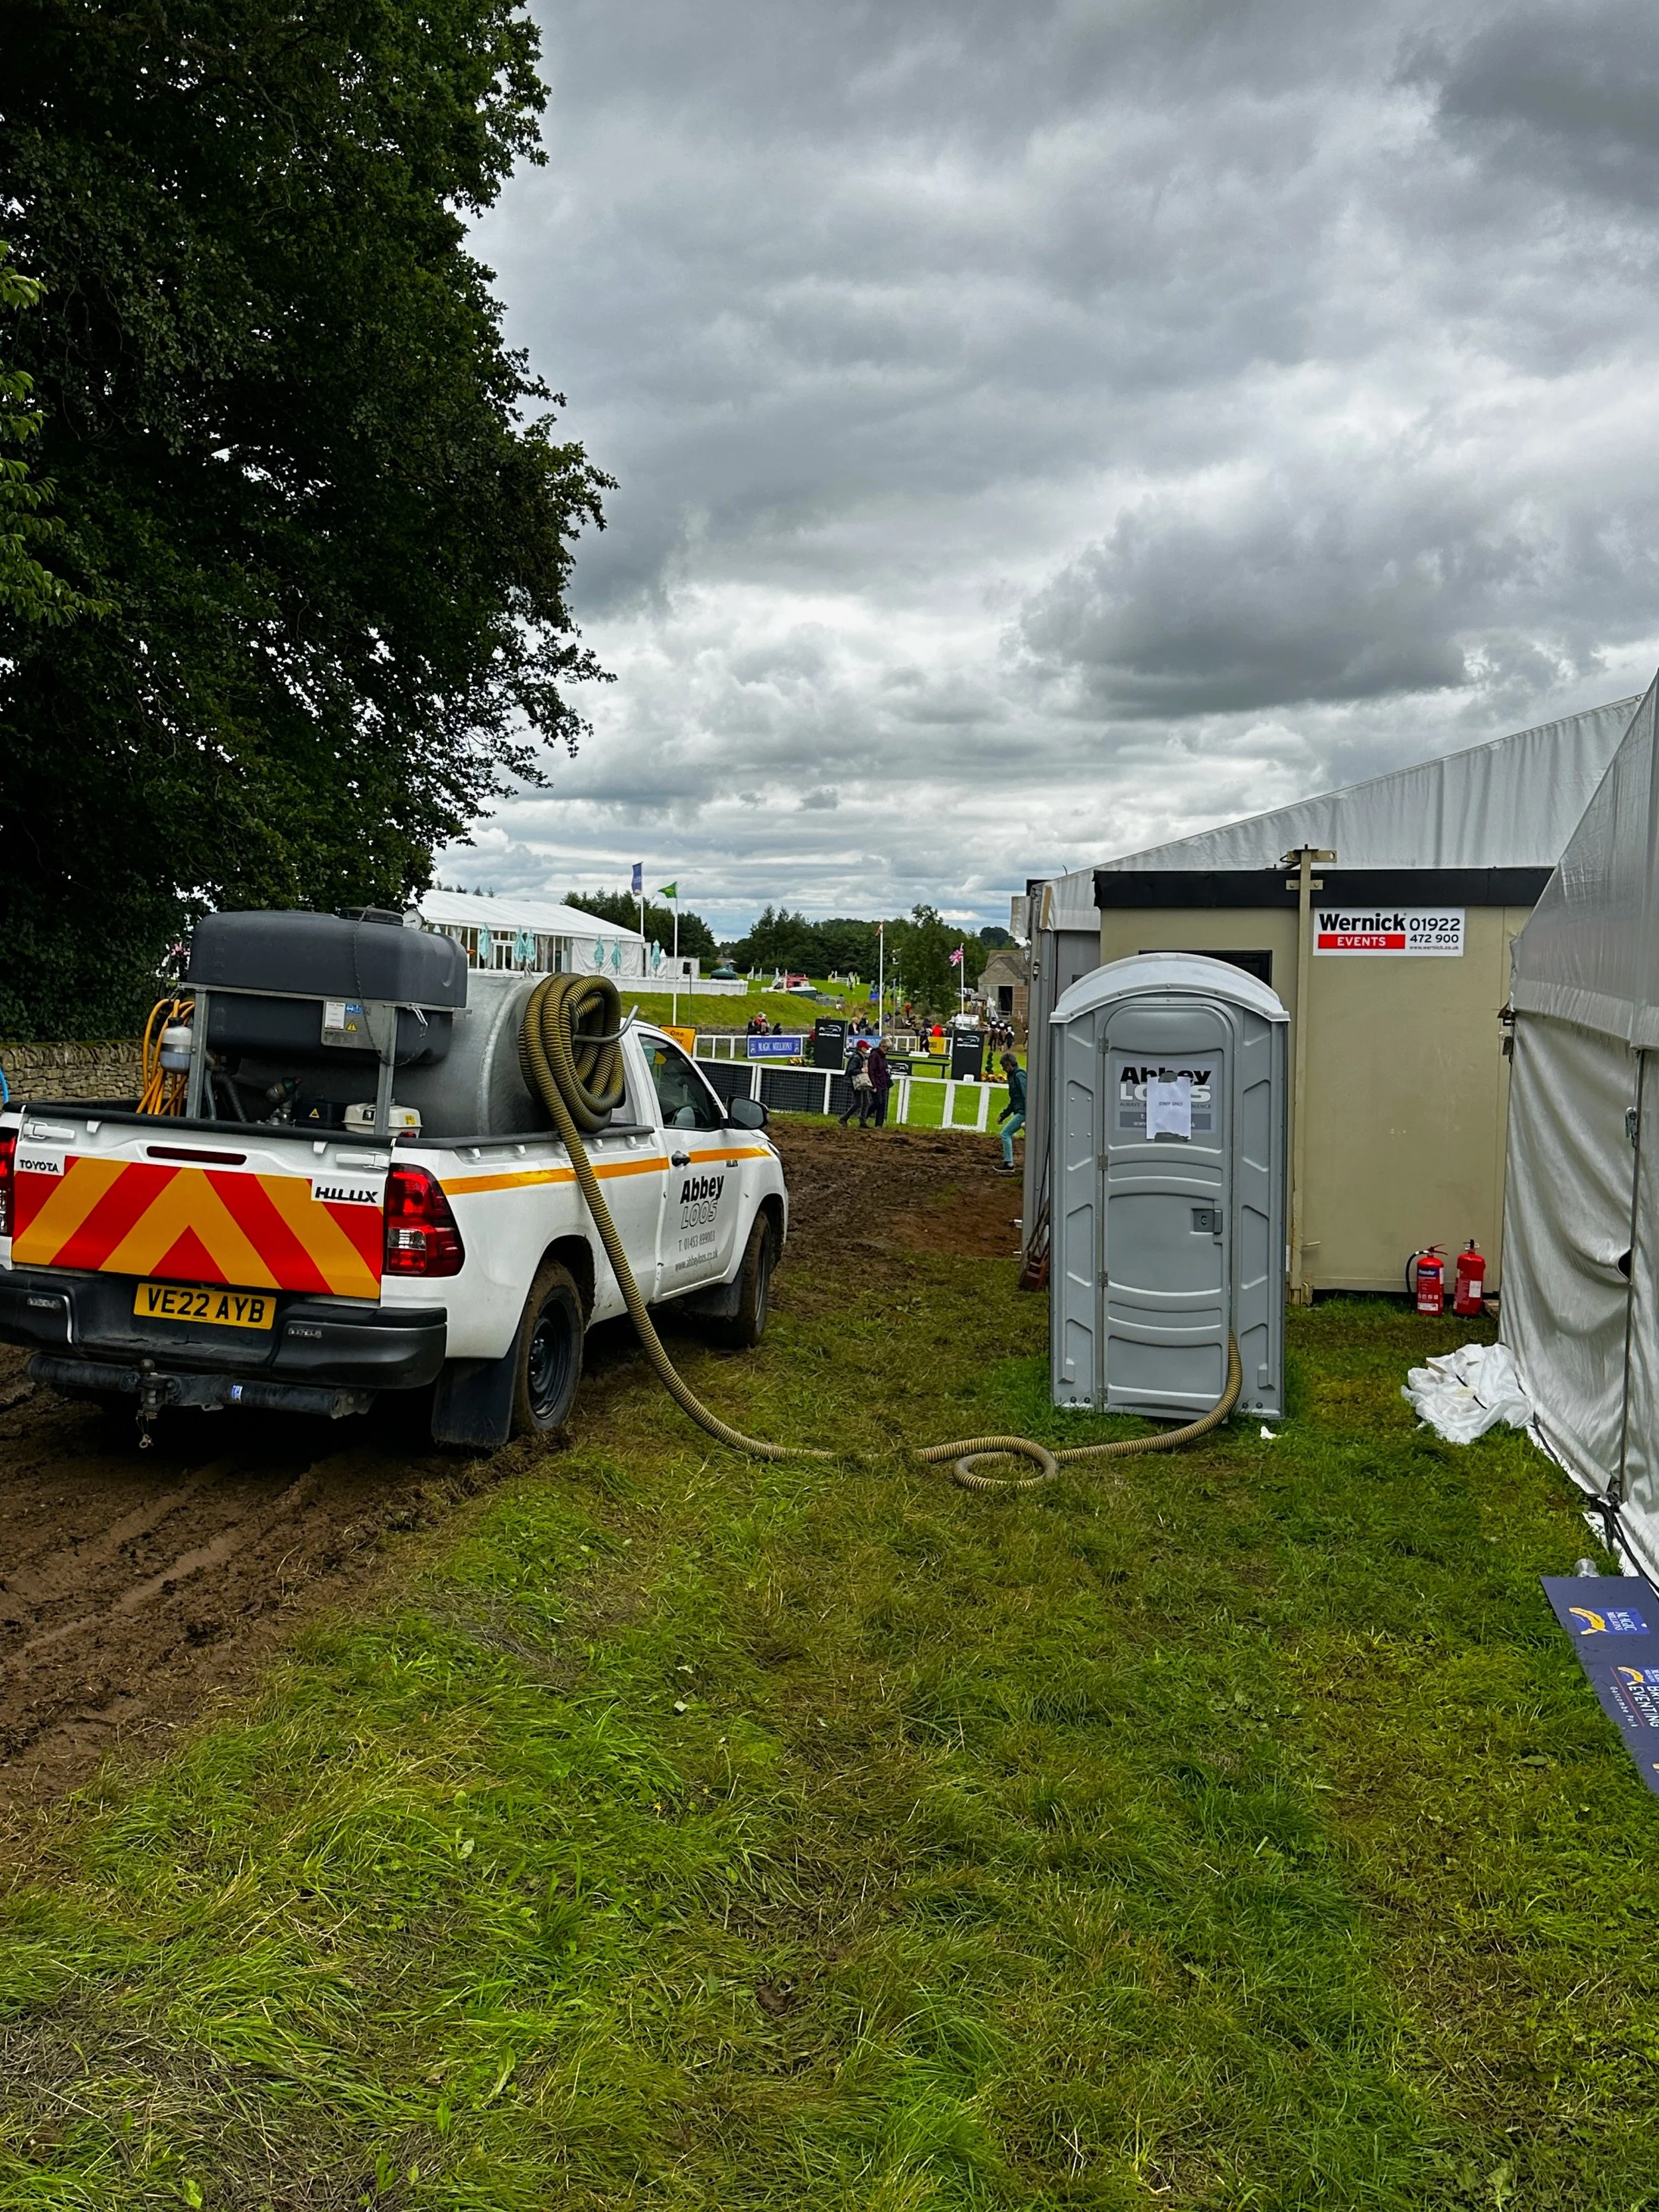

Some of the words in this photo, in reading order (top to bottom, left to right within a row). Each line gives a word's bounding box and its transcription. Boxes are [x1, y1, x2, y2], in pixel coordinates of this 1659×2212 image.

[1319, 913, 1406, 931] Wernick
[1409, 918, 1460, 932] 01922
[1337, 936, 1386, 946] EVENTS
[1409, 934, 1432, 943] 472
[1435, 934, 1459, 943] 900
[19, 1160, 59, 1173] TOYOTA
[315, 1187, 378, 1203] HILUX
[680, 1176, 724, 1204] Abbey
[681, 1199, 718, 1229] LOOS
[684, 1235, 698, 1250] 01453
[148, 1288, 210, 1317] VE22
[215, 1296, 264, 1322] AYB
[1615, 1612, 1637, 1631] MAGIC
[1609, 1686, 1629, 1713] Gatcombe
[1628, 1686, 1659, 1728] EVENTING
